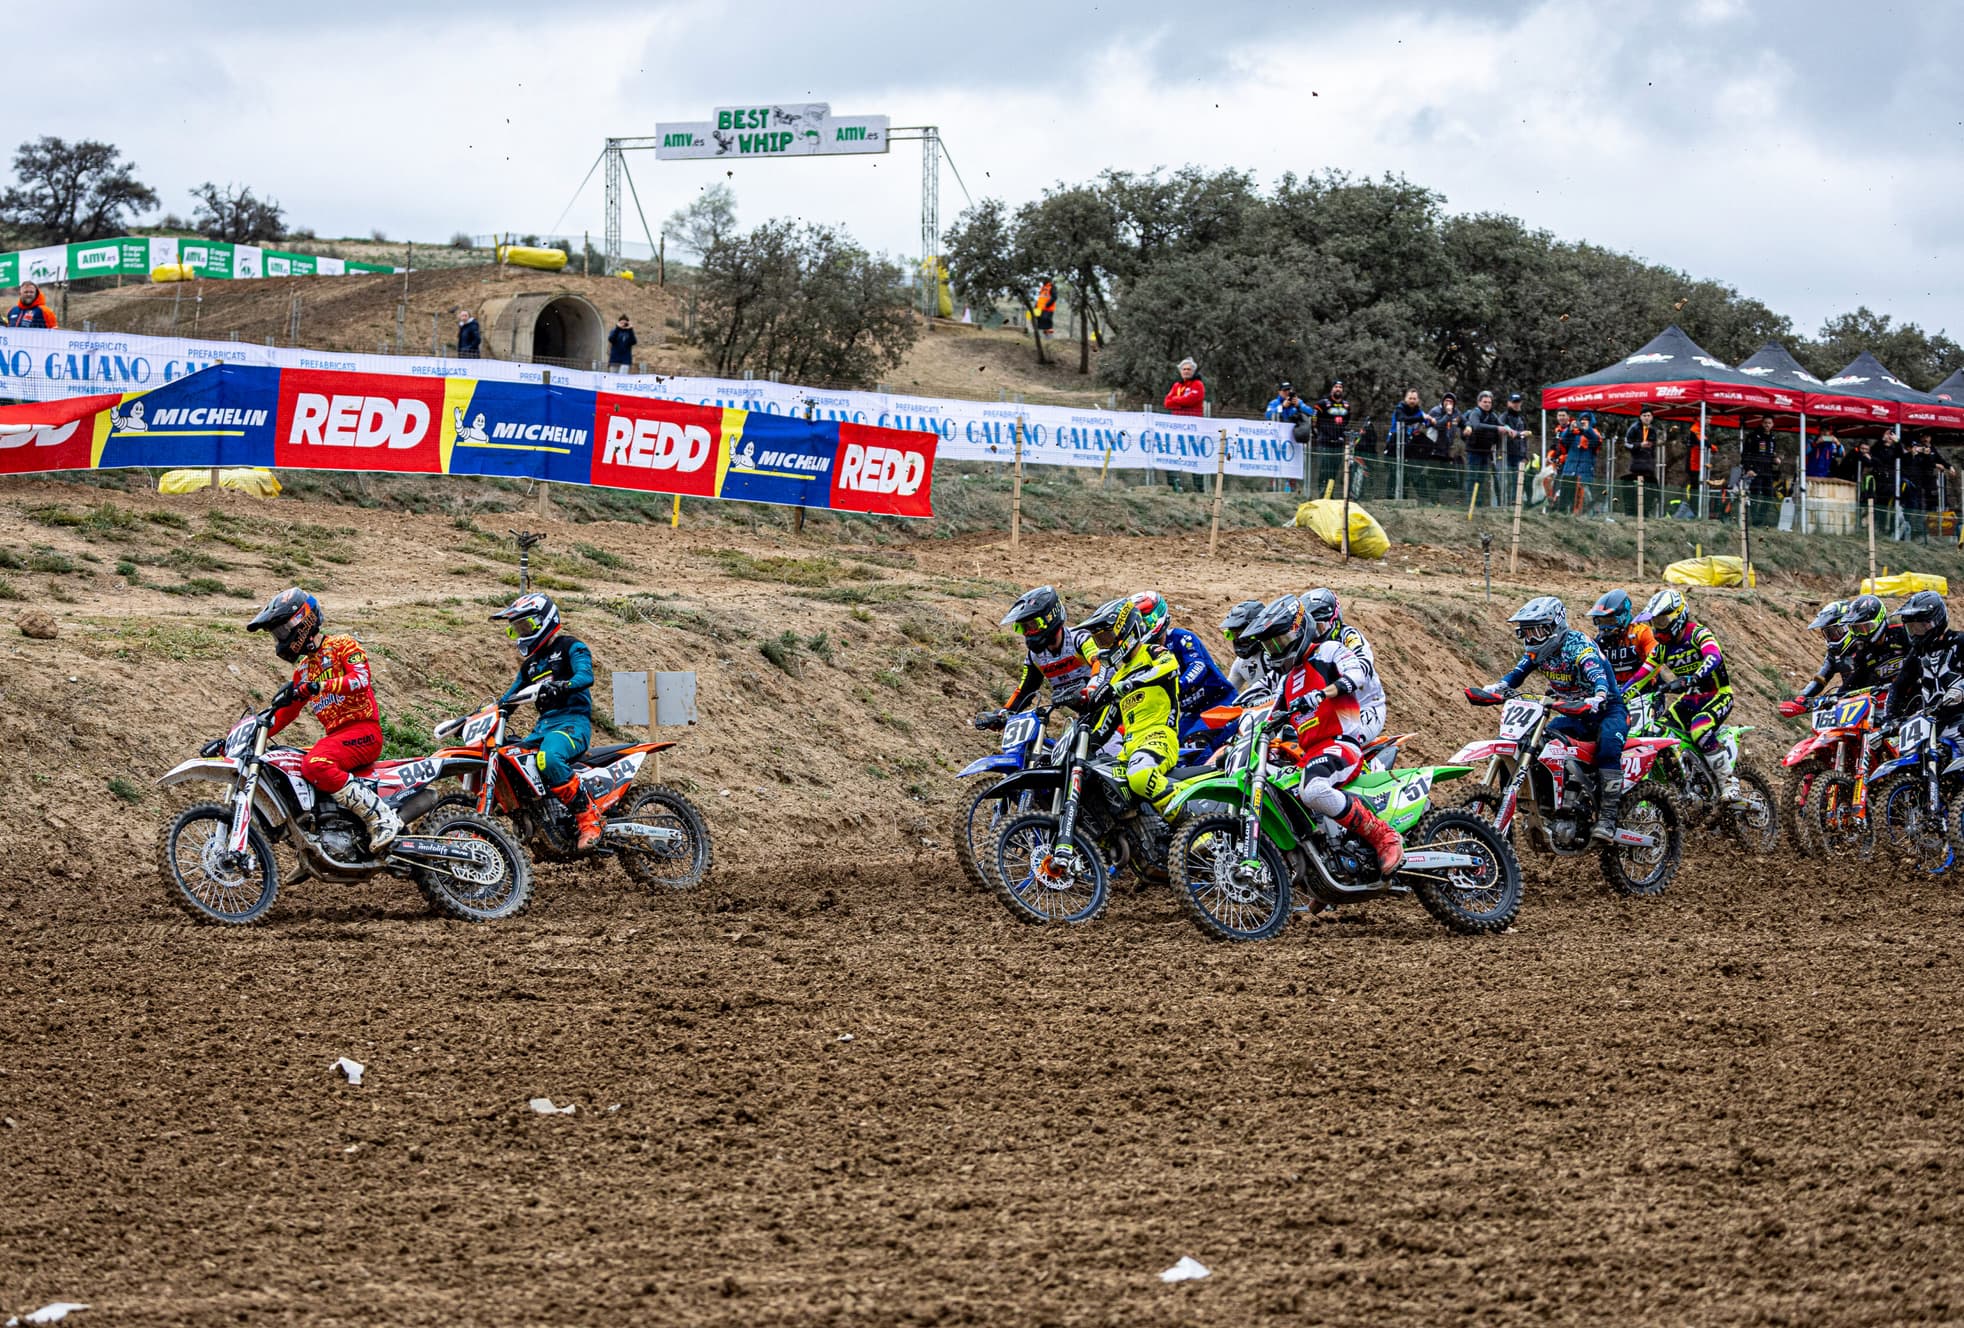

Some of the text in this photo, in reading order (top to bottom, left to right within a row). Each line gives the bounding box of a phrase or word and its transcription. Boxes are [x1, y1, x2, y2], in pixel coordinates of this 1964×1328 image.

[718, 108, 770, 130] BEST
[738, 131, 794, 153] WHIP
[68, 340, 128, 351] PREFABRICATS
[187, 348, 247, 361] PREFABRICATS
[300, 359, 356, 371] PREFABRICATS
[411, 366, 467, 376] PREFABRICATS
[616, 382, 668, 394] PREFABRICATS
[151, 408, 268, 427] MICHELIN
[289, 392, 431, 449] REDD
[491, 422, 588, 446] MICHELIN
[602, 415, 712, 473] REDD
[1056, 425, 1132, 453] GALANO
[1139, 429, 1215, 458] GALANO
[757, 450, 831, 472] MICHELIN
[838, 443, 925, 496] REDD
[1503, 705, 1536, 728] 124
[1839, 701, 1866, 724] 17
[464, 718, 491, 743] 64
[1003, 719, 1031, 745] 31
[1900, 719, 1923, 749] 14
[398, 759, 436, 787] 848
[607, 759, 636, 779] 64
[1404, 777, 1430, 802] 51
